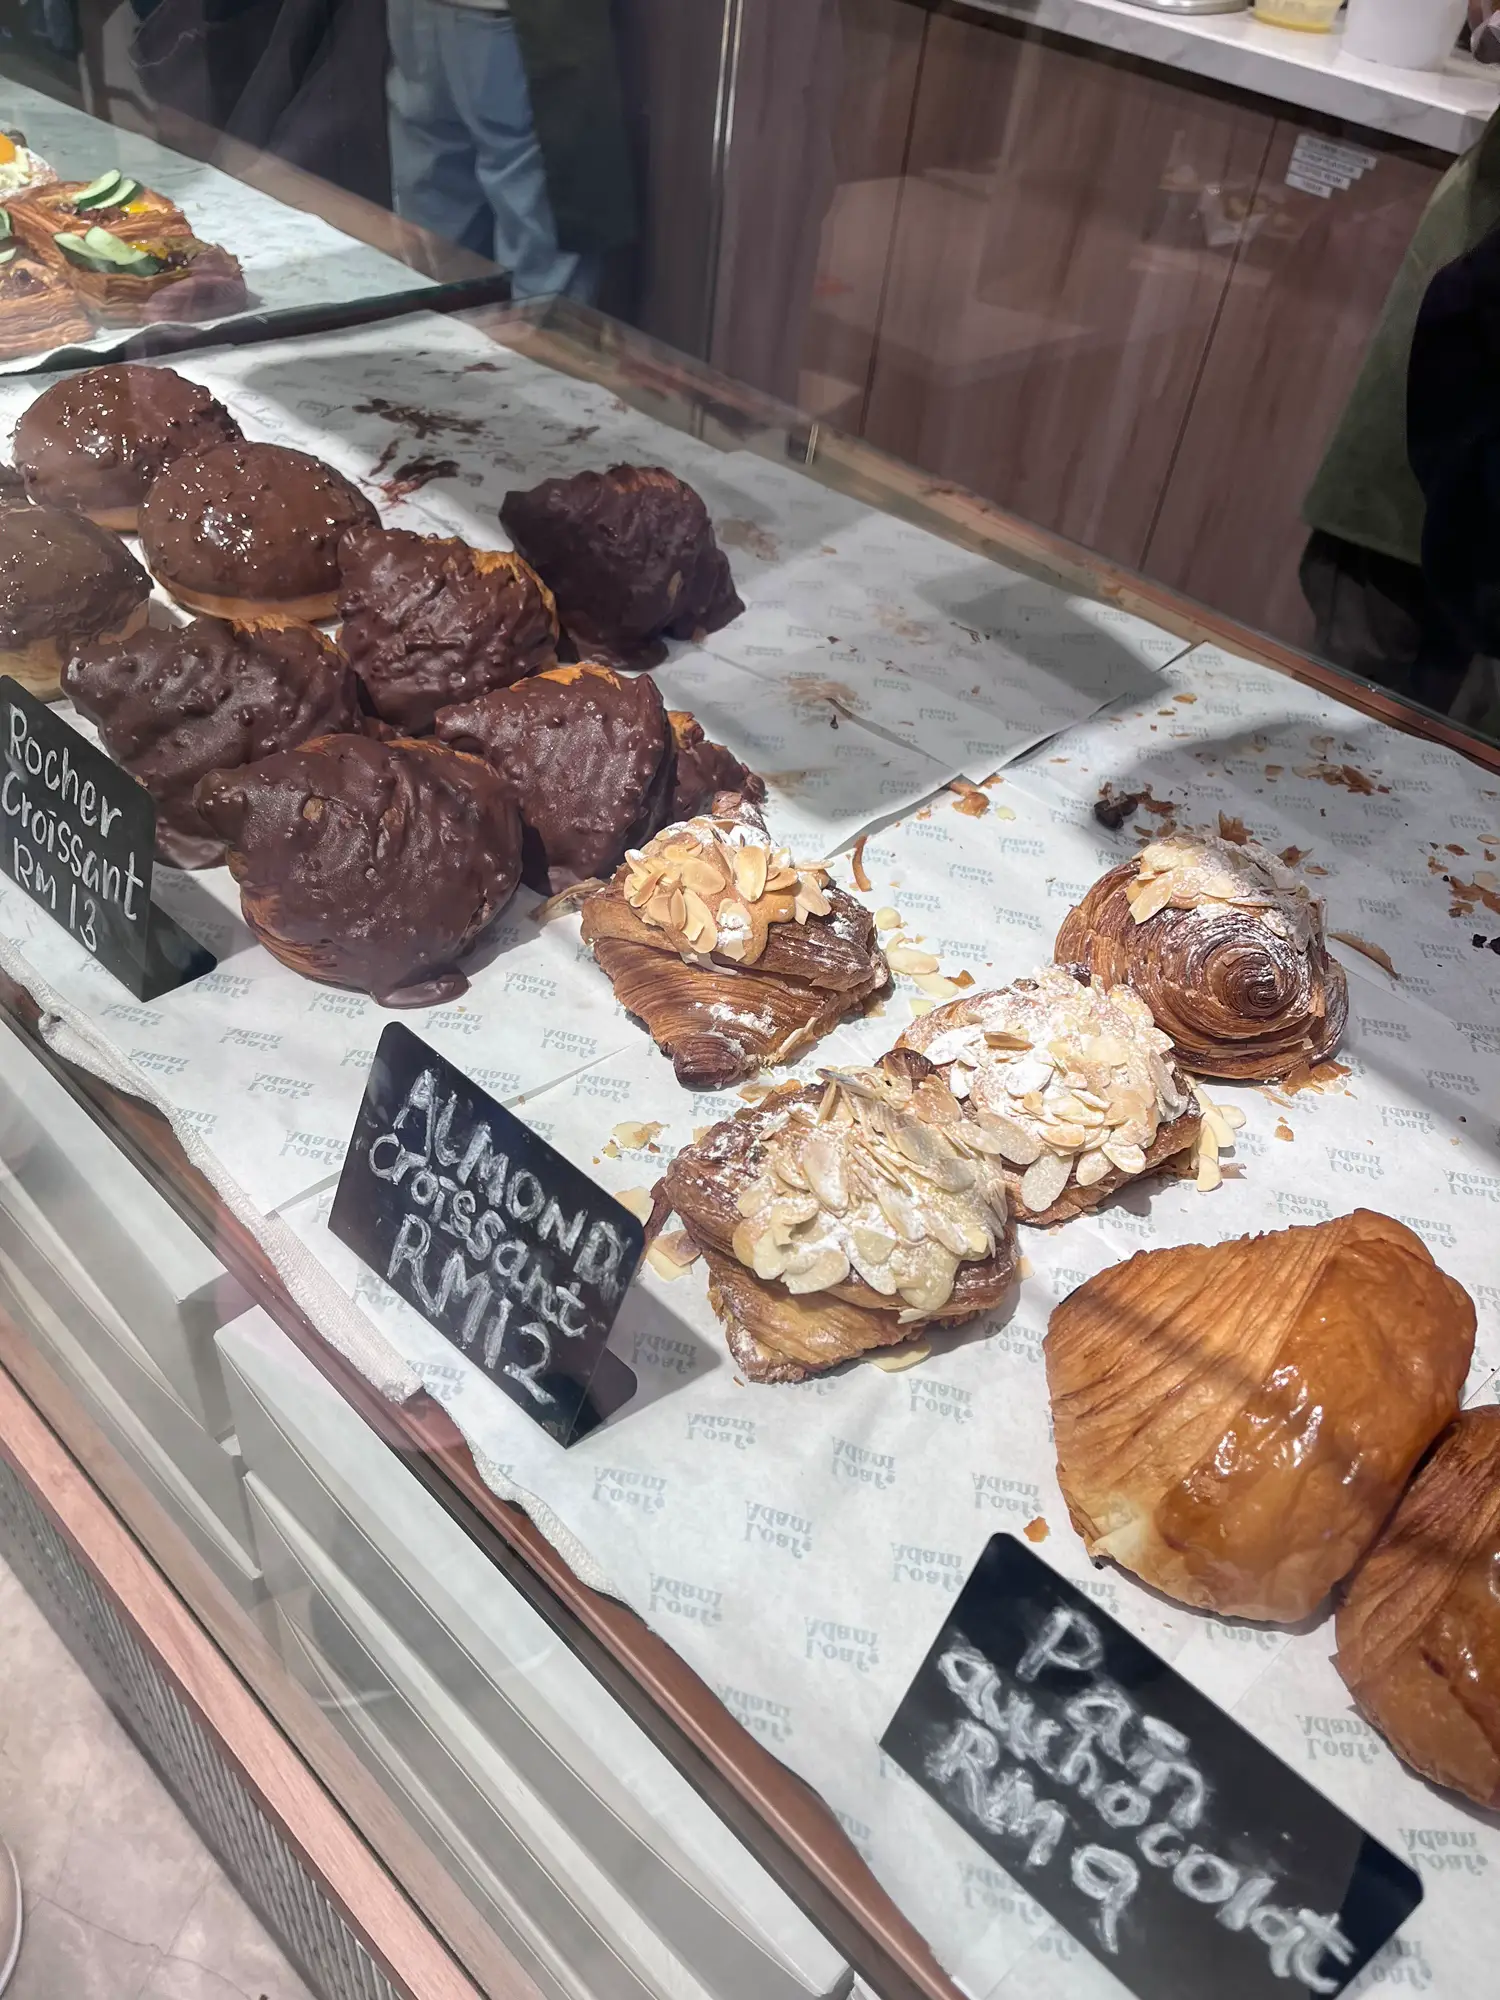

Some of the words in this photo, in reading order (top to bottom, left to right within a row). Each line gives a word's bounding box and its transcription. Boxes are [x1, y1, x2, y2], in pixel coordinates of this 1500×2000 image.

[1, 770, 144, 920] Croissant
[9, 702, 122, 838] Rocher
[368, 1132, 588, 1340] Croissant
[391, 1068, 630, 1287] ALMOND
